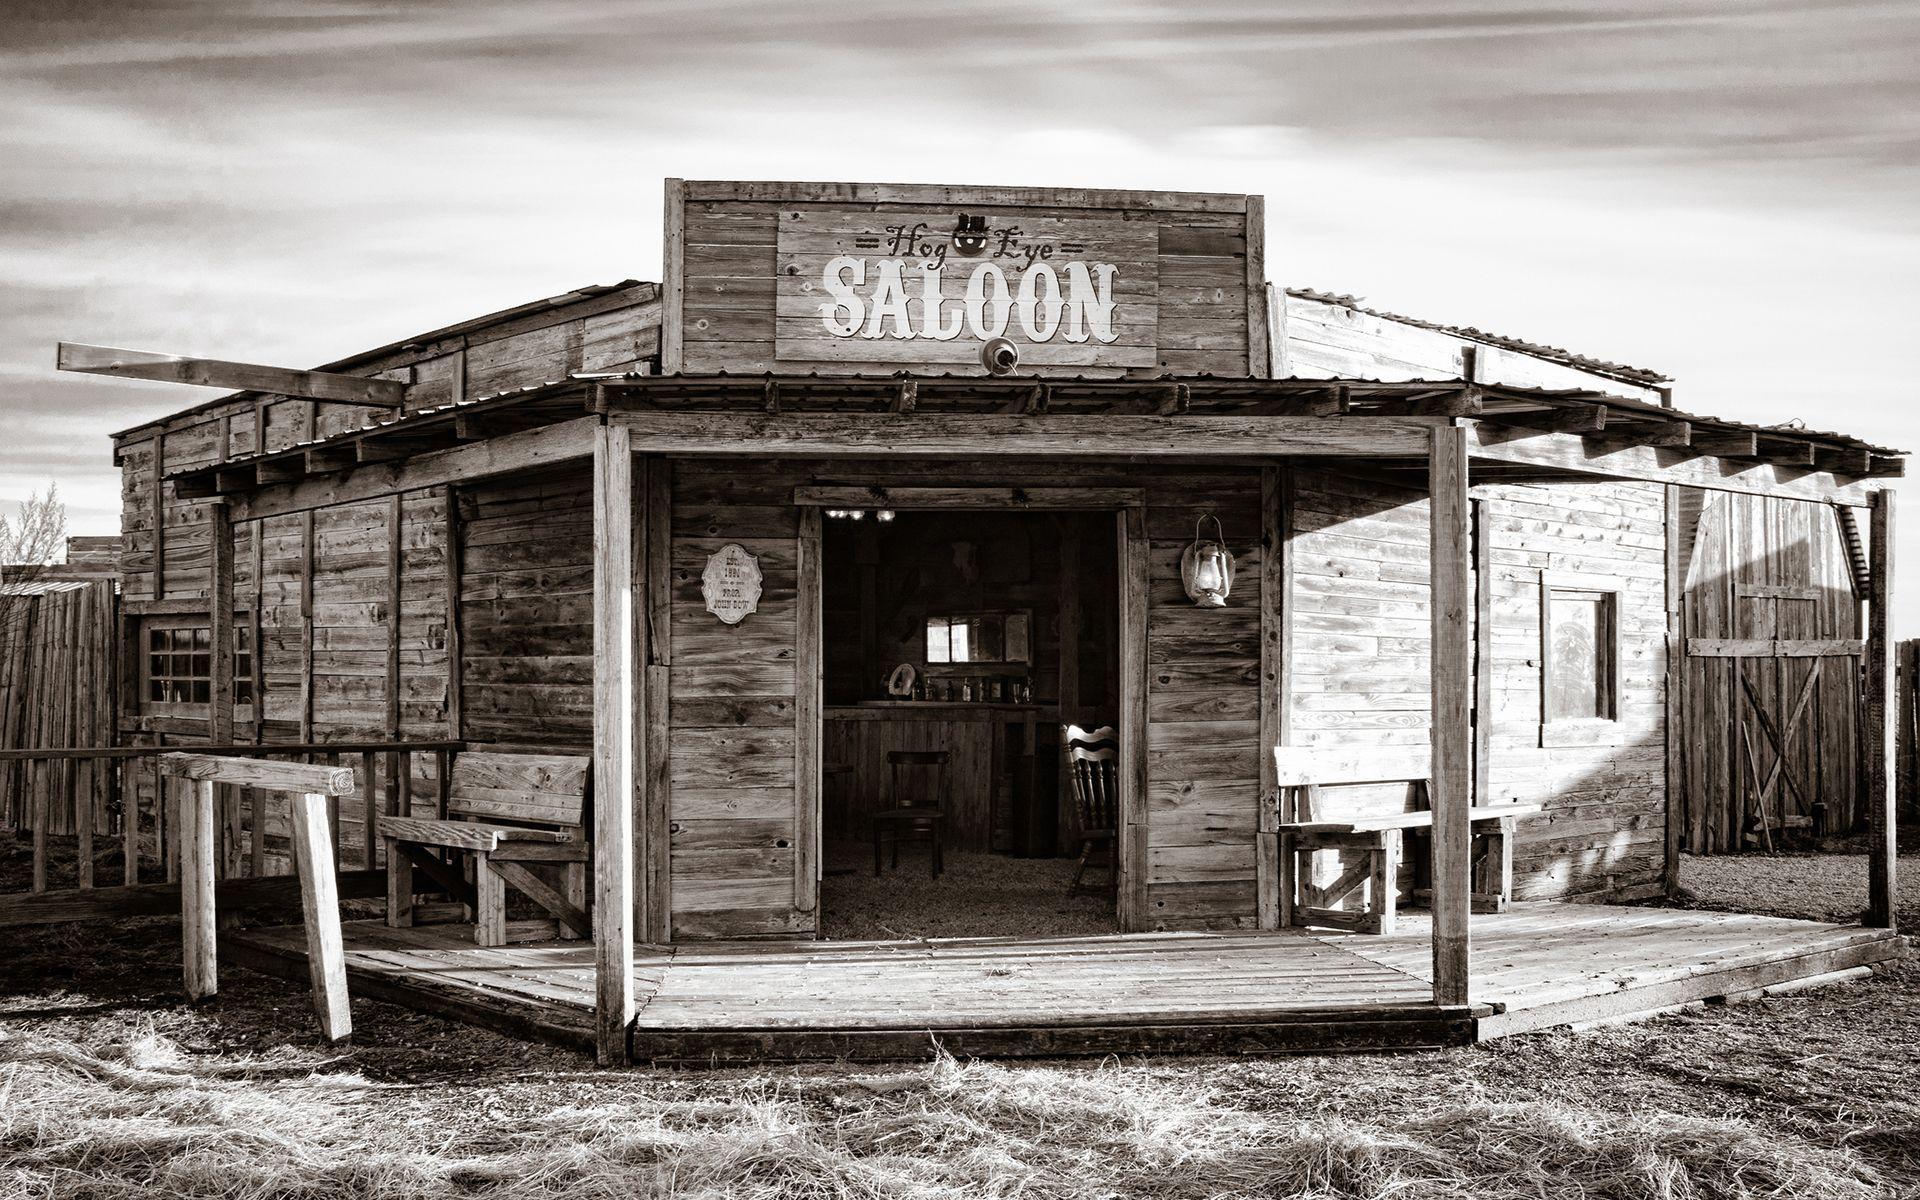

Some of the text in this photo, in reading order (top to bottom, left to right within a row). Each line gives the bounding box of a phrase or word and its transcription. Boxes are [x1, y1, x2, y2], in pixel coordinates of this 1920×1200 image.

[885, 223, 1054, 272] Hog Eye
[818, 257, 1120, 343] SALOON
